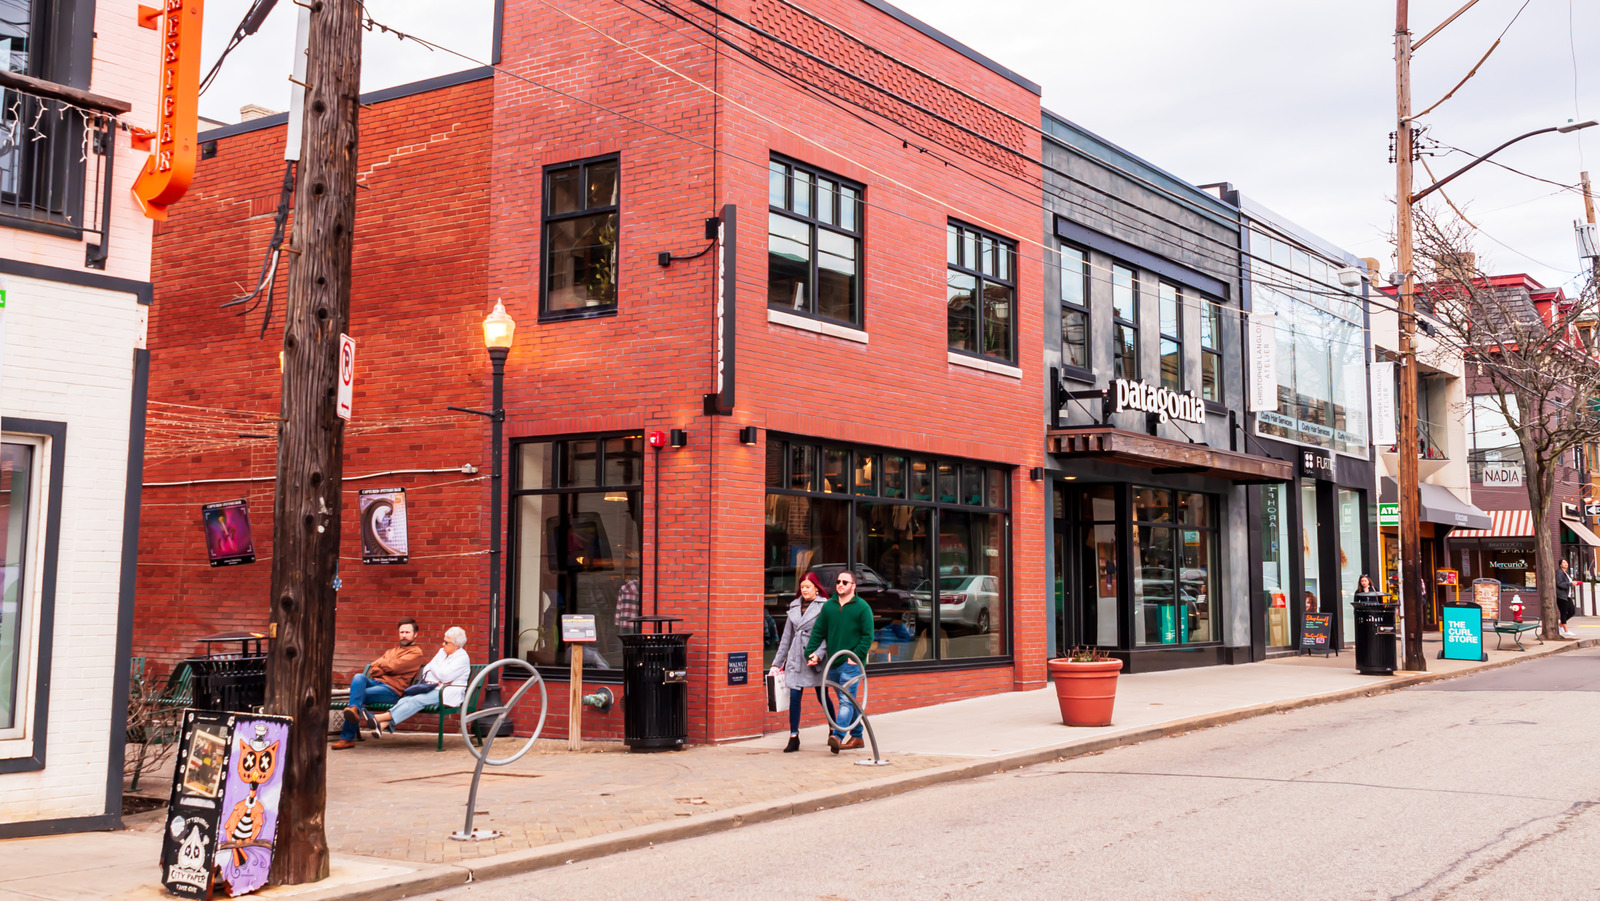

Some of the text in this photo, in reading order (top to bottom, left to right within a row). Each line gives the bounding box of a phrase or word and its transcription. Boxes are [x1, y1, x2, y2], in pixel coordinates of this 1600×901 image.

[1116, 378, 1206, 424] patagonia
[1261, 411, 1270, 423] Curly
[1279, 416, 1293, 427] Services
[1301, 423, 1310, 433] Curly
[1317, 427, 1331, 437] Services
[1485, 469, 1519, 482] NADIA
[1489, 560, 1528, 569] Mercurio's
[1448, 628, 1473, 636] CURL
[1448, 635, 1478, 643] STORE
[171, 869, 206, 884] CITY PAPER
